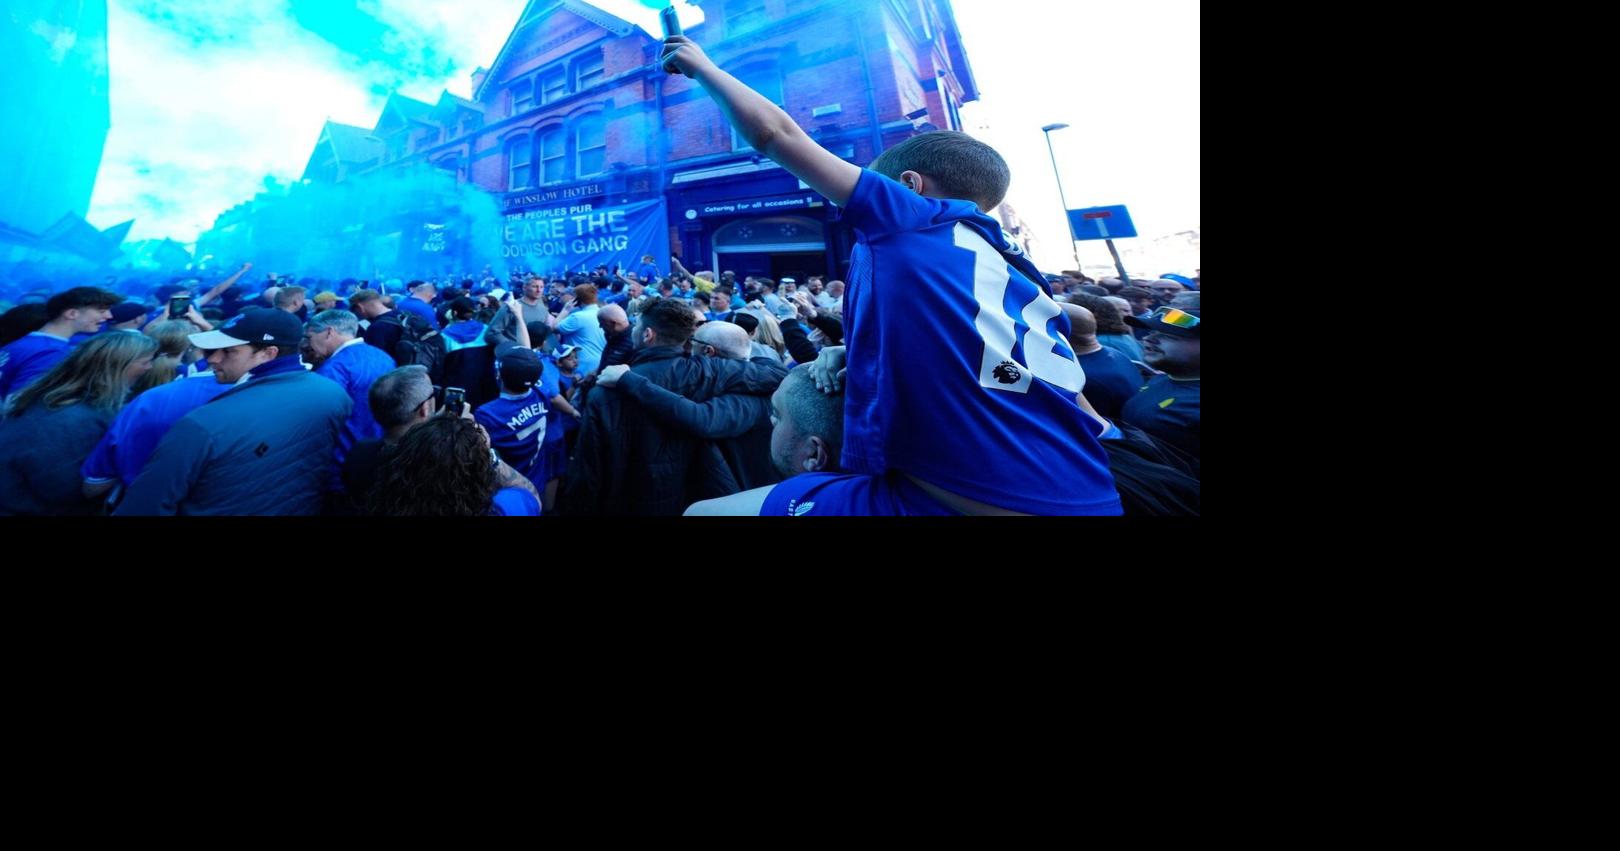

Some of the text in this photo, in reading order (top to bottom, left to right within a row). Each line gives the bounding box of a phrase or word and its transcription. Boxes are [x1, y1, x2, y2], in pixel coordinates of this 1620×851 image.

[514, 190, 558, 205] WINSLOW
[563, 184, 602, 199] HOTEL
[506, 213, 523, 221] THE
[525, 207, 567, 219] PEOPLES
[704, 204, 735, 213] Catering
[764, 199, 804, 207] occasions
[521, 217, 566, 241] ARE
[571, 210, 628, 236] THE
[502, 234, 628, 258] OODISON GANG
[516, 415, 547, 466] 7
